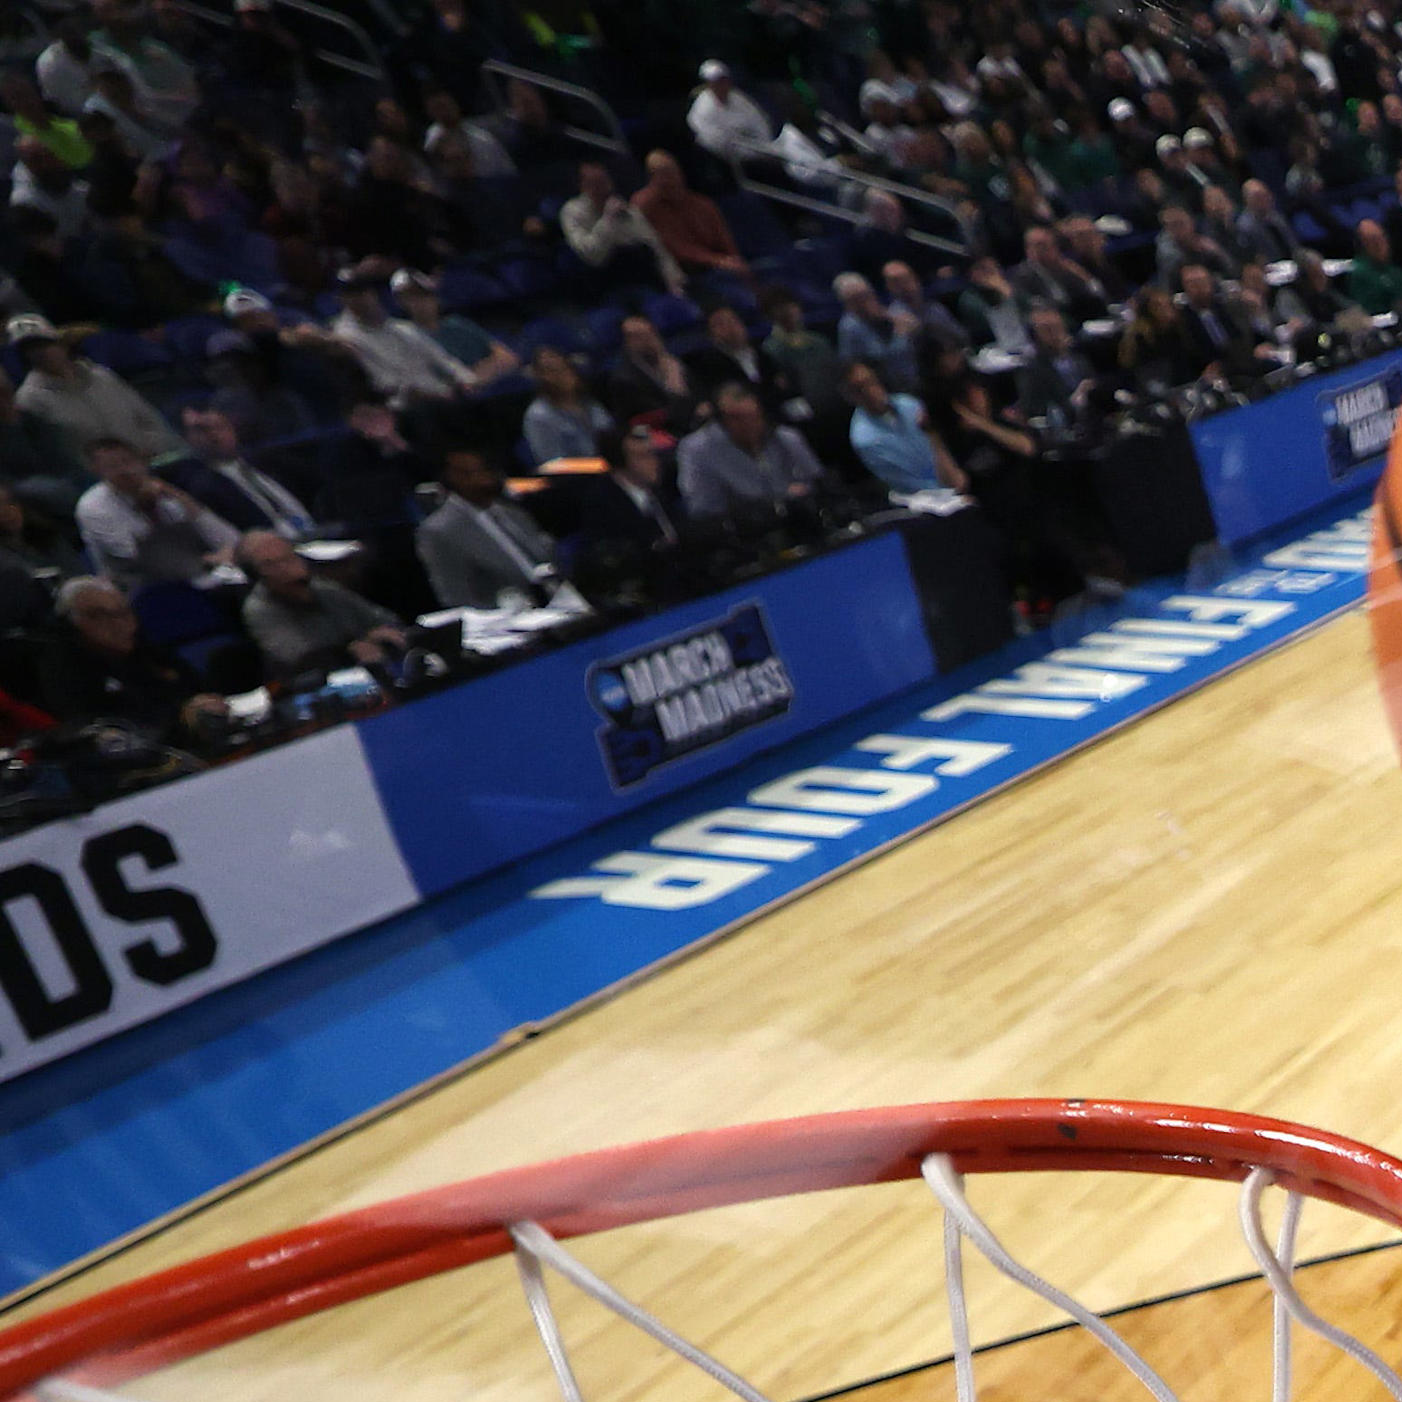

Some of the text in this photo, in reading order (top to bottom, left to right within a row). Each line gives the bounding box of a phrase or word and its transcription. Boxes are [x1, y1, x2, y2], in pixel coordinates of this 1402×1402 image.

[621, 632, 733, 705] MARCH
[655, 658, 791, 740] MADNESS
[528, 595, 1298, 911] FINAL FOUR
[0, 824, 218, 1044] DS
